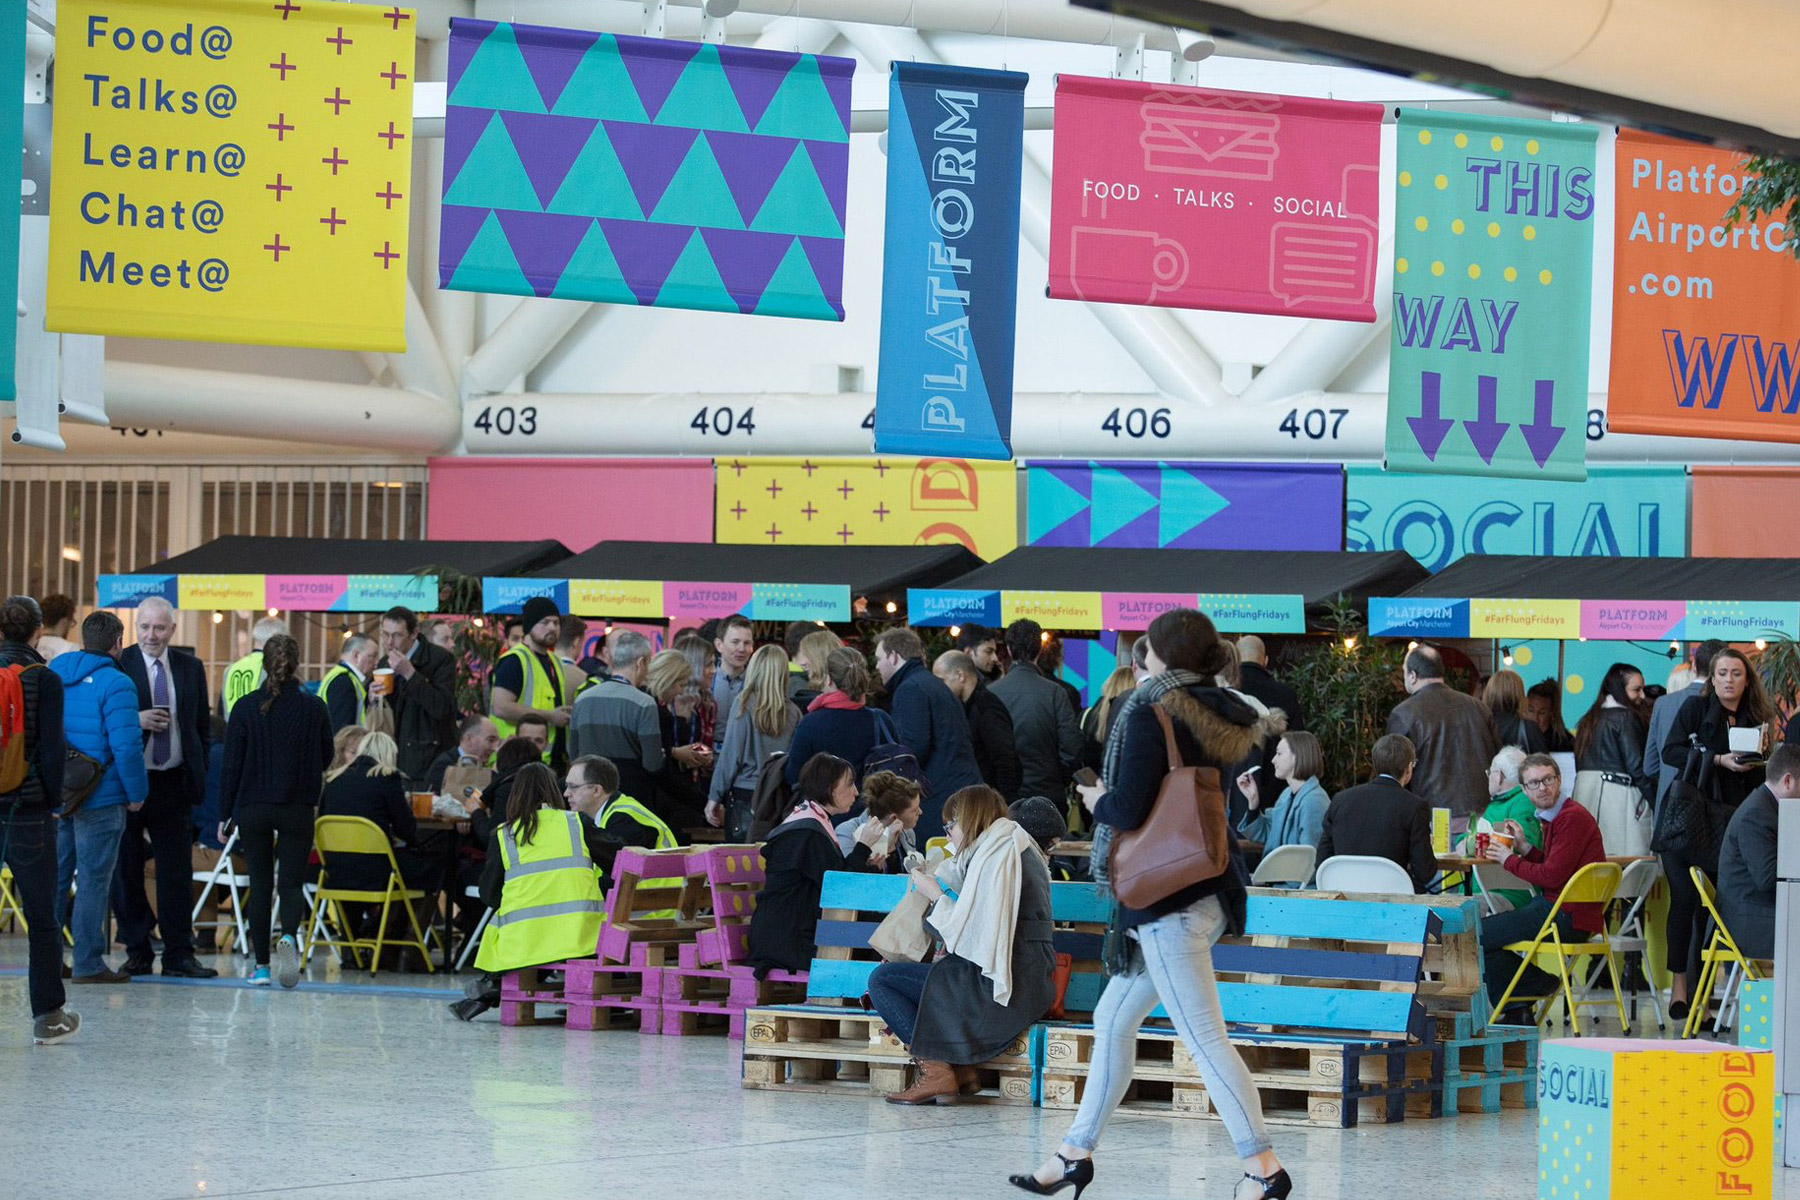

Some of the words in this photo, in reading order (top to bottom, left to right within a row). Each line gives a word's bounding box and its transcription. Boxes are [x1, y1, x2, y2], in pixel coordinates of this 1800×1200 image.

[87, 15, 233, 60] Food@
[84, 73, 237, 118] Talks@
[83, 132, 246, 177] Learn@
[1466, 156, 1594, 221] THIS
[1632, 158, 1774, 197] Platfor
[80, 191, 224, 234] Chat@
[1082, 180, 1141, 201] FOOD
[1173, 188, 1235, 209] TALKS
[1273, 196, 1348, 219] SOCIAL
[1629, 211, 1788, 253] AirportC
[79, 249, 230, 292] Meet@
[921, 88, 979, 433] PLATFORM
[1629, 270, 1714, 299] .com
[1393, 292, 1519, 354] WAY
[473, 406, 538, 436] 403
[690, 407, 755, 437] 404
[1101, 407, 1172, 439] 406
[1279, 408, 1349, 440] 407
[112, 582, 165, 594] PLATFORM
[279, 583, 333, 594] PLATFORM
[360, 590, 425, 600] #FarFlungFridays
[498, 586, 555, 599] PLATFORM
[679, 590, 738, 602] PLATFORM
[766, 598, 837, 609] #FarFlungFridays
[924, 597, 985, 610] PLATFORM
[1014, 606, 1089, 617] #FarFlungFridays
[1212, 609, 1290, 621] #FarFlungFridays
[1386, 607, 1453, 619] PLATFORM
[1598, 608, 1668, 620] PLATFORM
[1407, 620, 1419, 629] City
[1484, 614, 1565, 626] #FarFlungFridays
[1599, 621, 1619, 630] Airport
[1620, 621, 1633, 630] City
[1700, 616, 1784, 628] #FarFlungFridays
[752, 1027, 772, 1038] EPAL
[1049, 1045, 1069, 1056] EPAL
[1539, 1060, 1609, 1109] SOCIAL
[1715, 1053, 1755, 1196] FOOD
